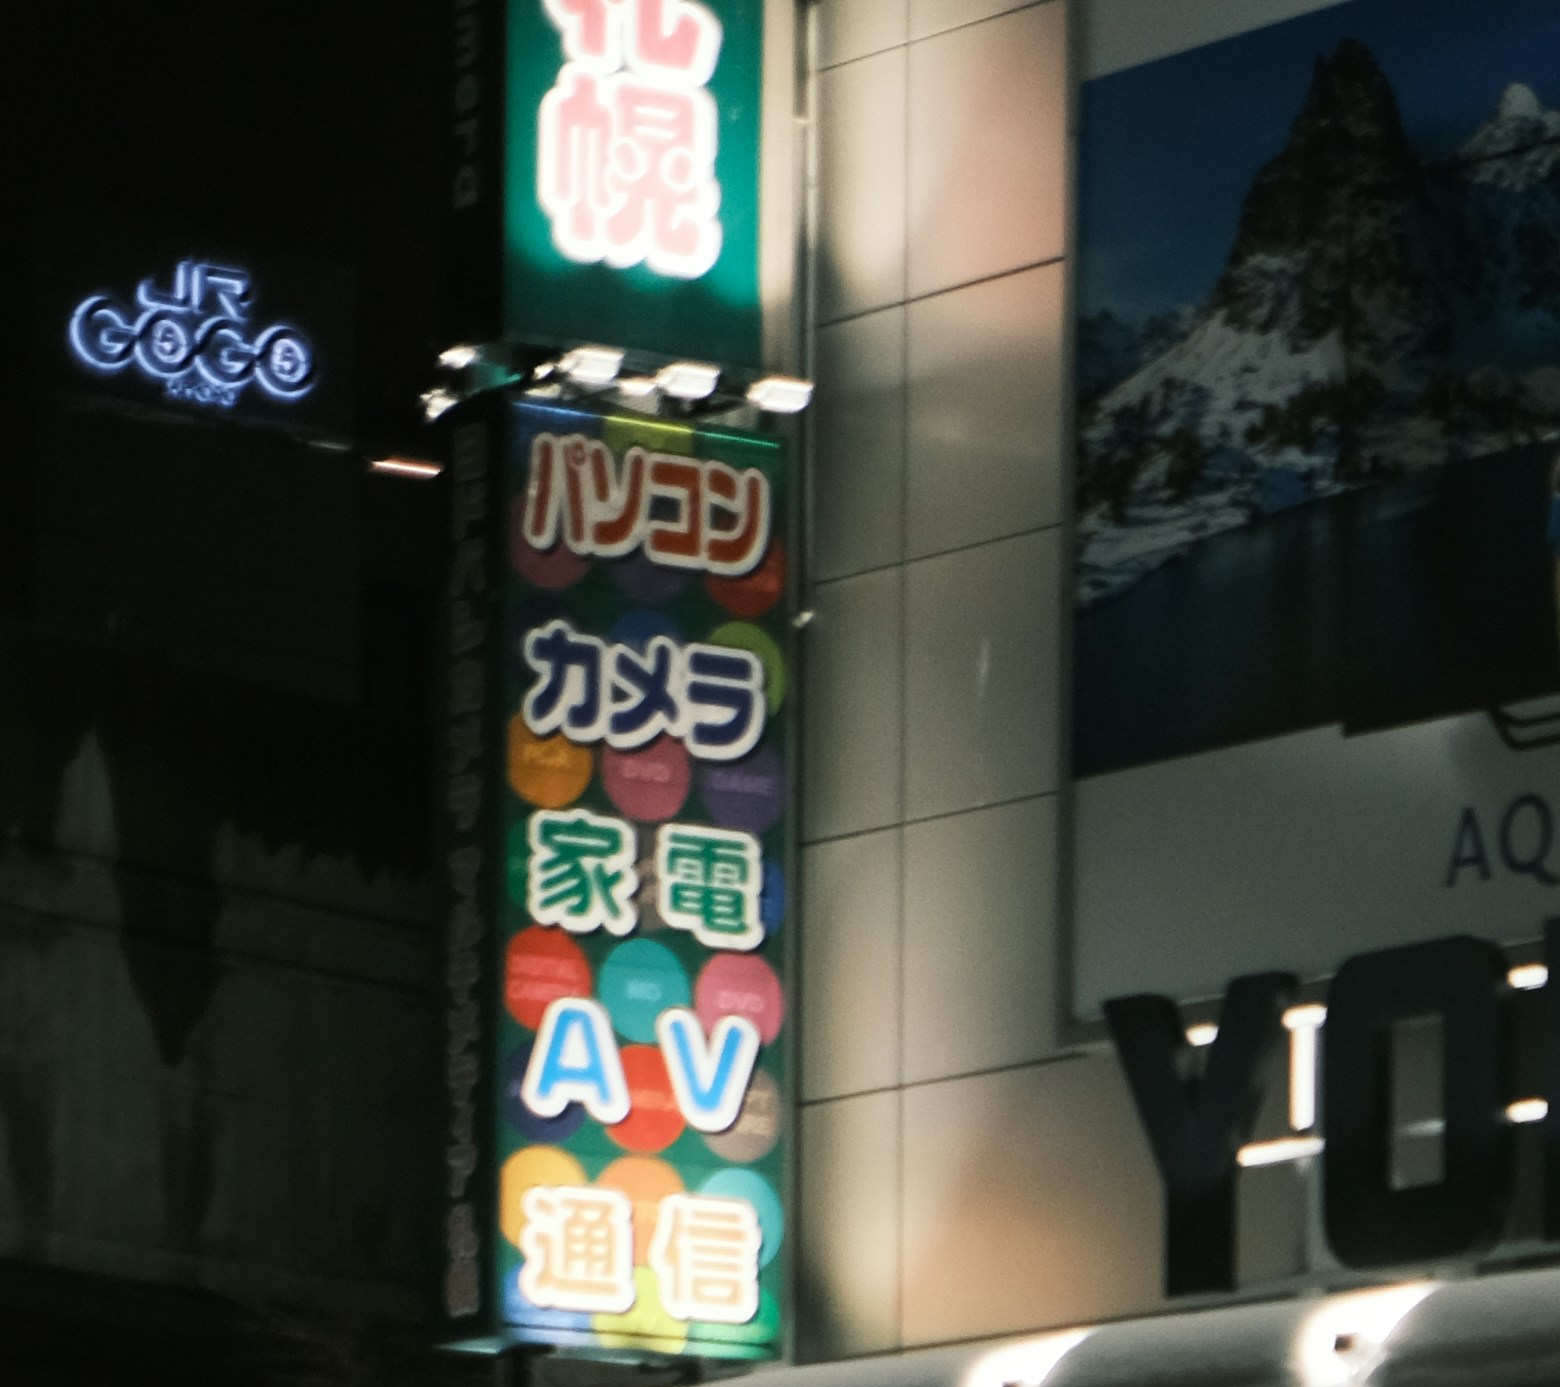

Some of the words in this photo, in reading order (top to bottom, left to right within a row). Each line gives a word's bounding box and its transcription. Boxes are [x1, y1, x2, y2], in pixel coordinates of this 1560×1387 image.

[526, 432, 772, 575] パソコン
[524, 619, 767, 760] カメラ
[527, 808, 764, 952] 家電
[522, 996, 760, 1133] AV
[518, 1184, 761, 1324] 通信
